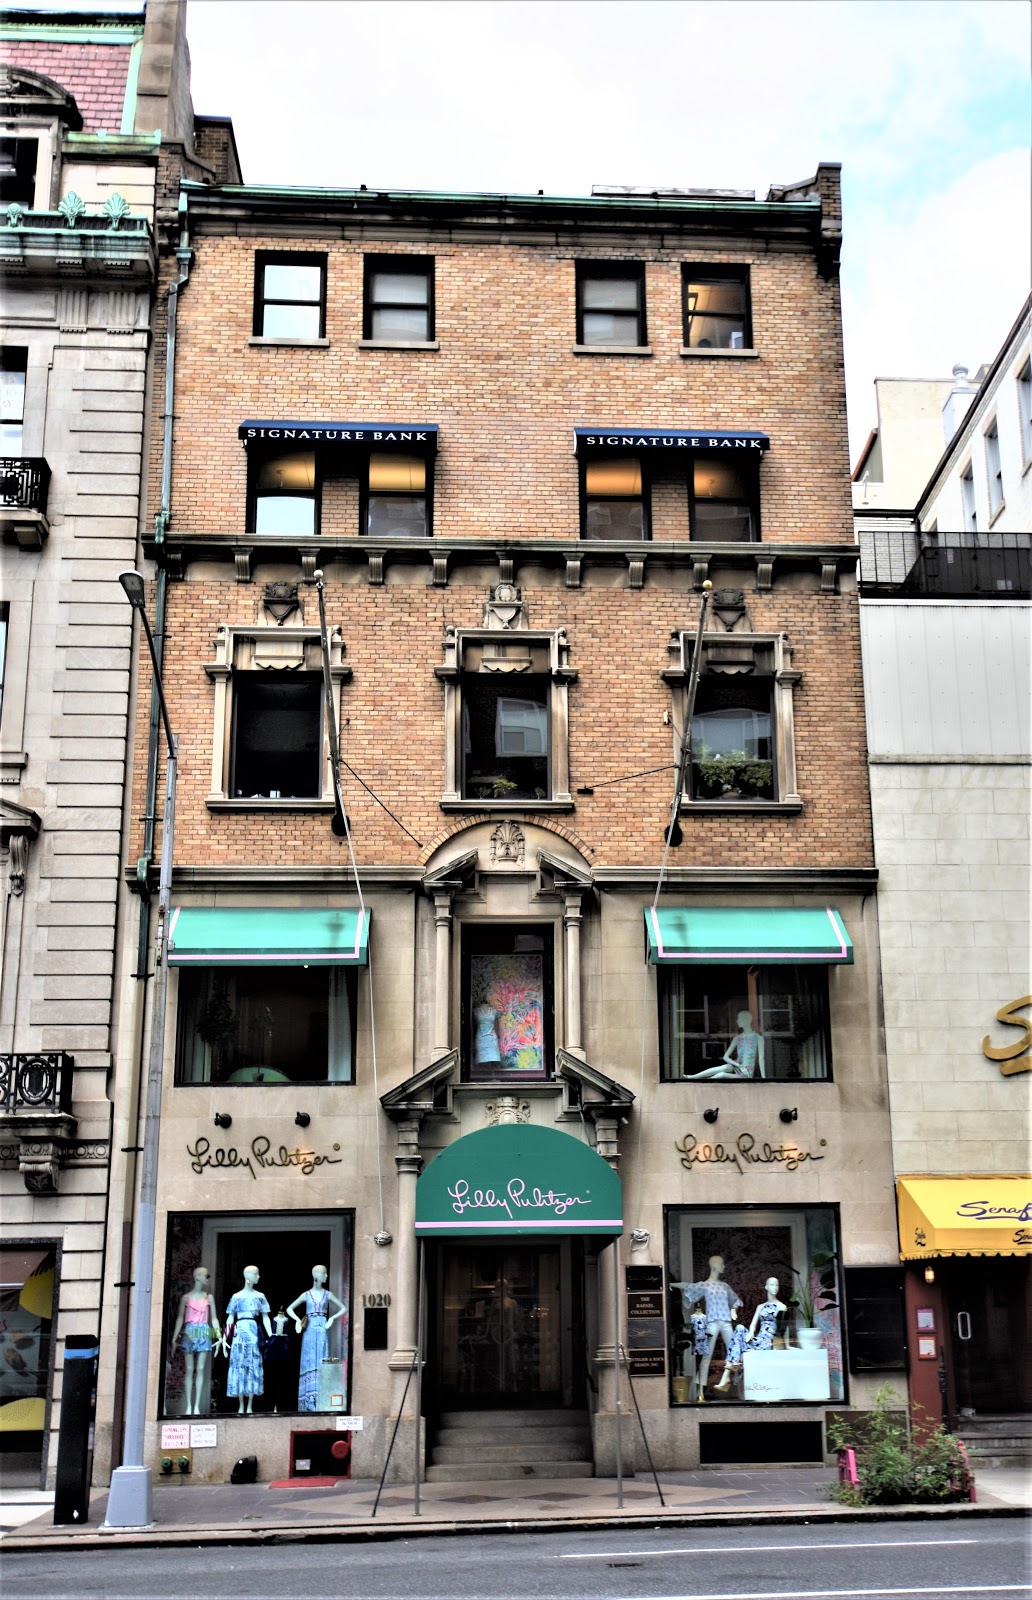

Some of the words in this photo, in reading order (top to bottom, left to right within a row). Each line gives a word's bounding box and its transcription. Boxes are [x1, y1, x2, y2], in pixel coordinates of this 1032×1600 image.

[247, 429, 364, 440] SIGNATURE
[373, 430, 427, 441] BANK
[586, 437, 700, 447] SIGNATURE
[708, 439, 761, 448] BANK
[187, 1137, 257, 1180] Lilly
[675, 1134, 744, 1175] Lilly
[447, 1179, 513, 1219] Lilly
[361, 1293, 392, 1308] 1020
